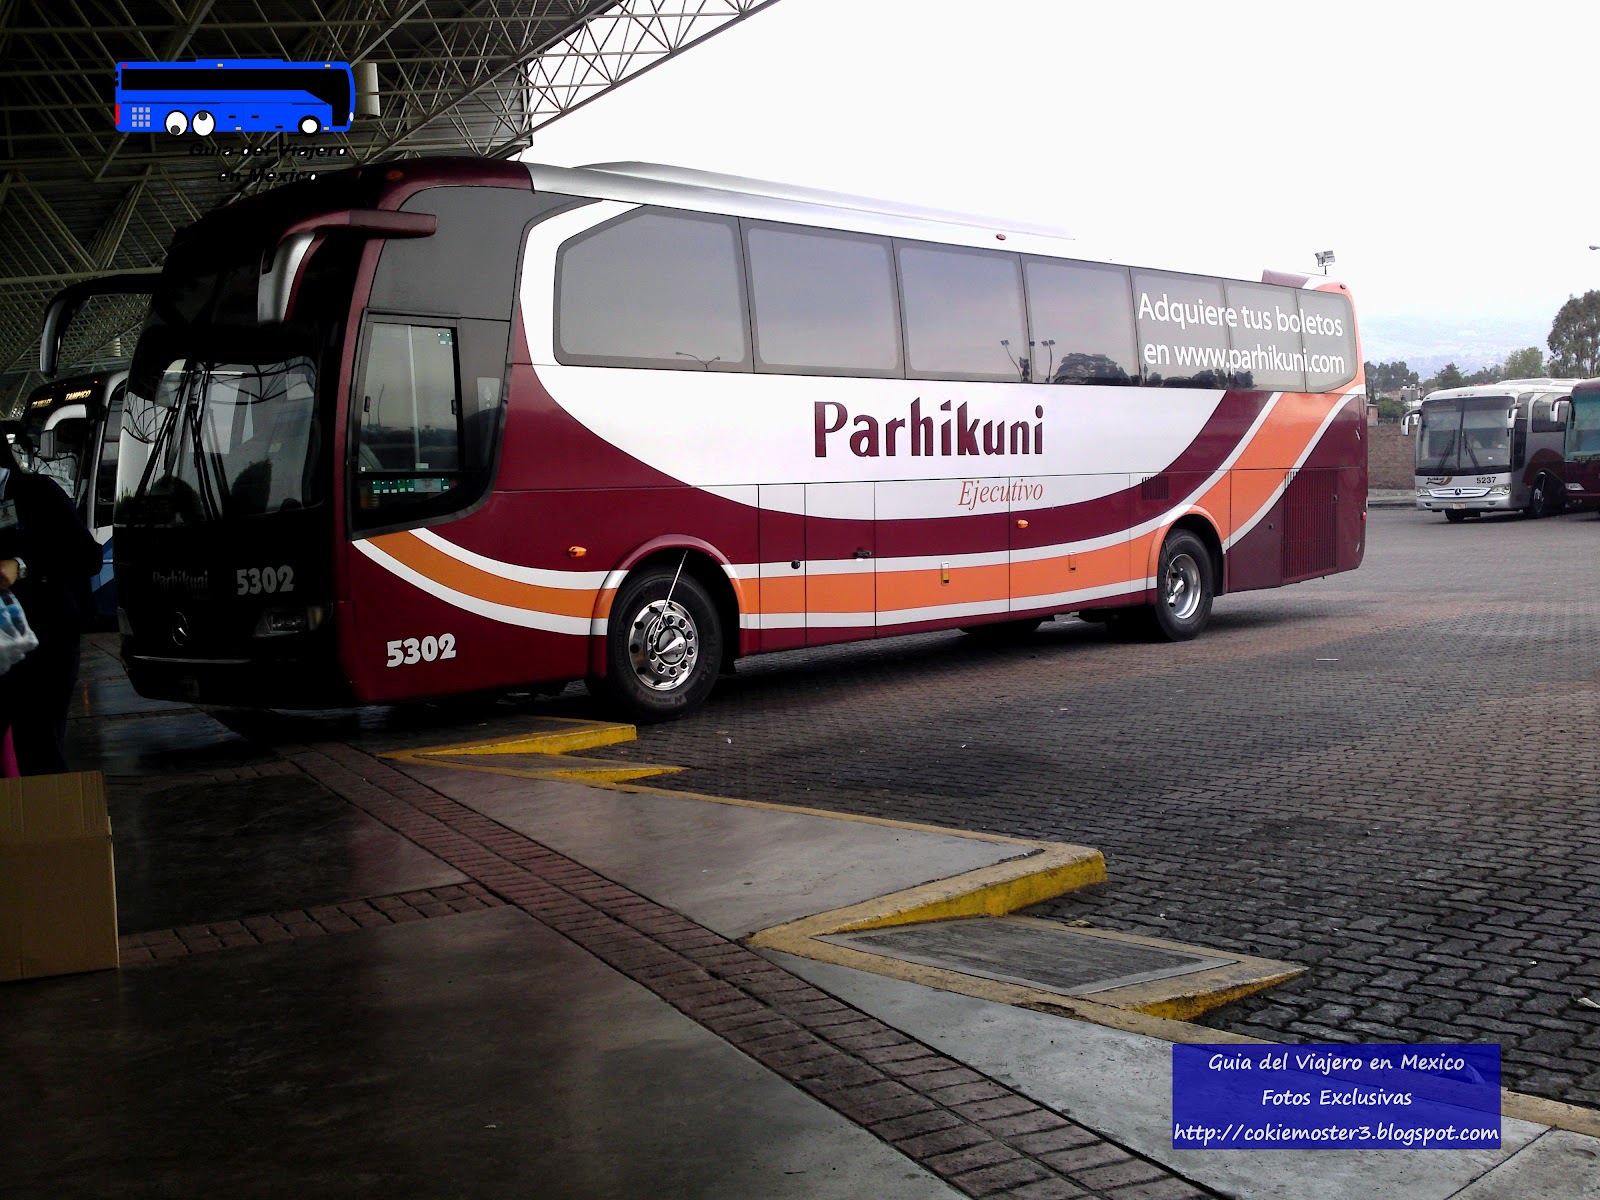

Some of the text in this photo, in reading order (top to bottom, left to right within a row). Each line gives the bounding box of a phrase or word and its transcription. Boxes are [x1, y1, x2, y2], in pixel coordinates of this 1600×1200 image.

[1138, 292, 1343, 336] Adquiere tus boletos
[1144, 343, 1345, 375] en www.parhikuni.com
[65, 389, 91, 401] TAMPICO
[814, 397, 1044, 457] Parhikuni
[958, 478, 1043, 510] Ejecutivo
[1476, 476, 1497, 484] 5237
[236, 565, 295, 596] 5302
[386, 633, 457, 668] 5302
